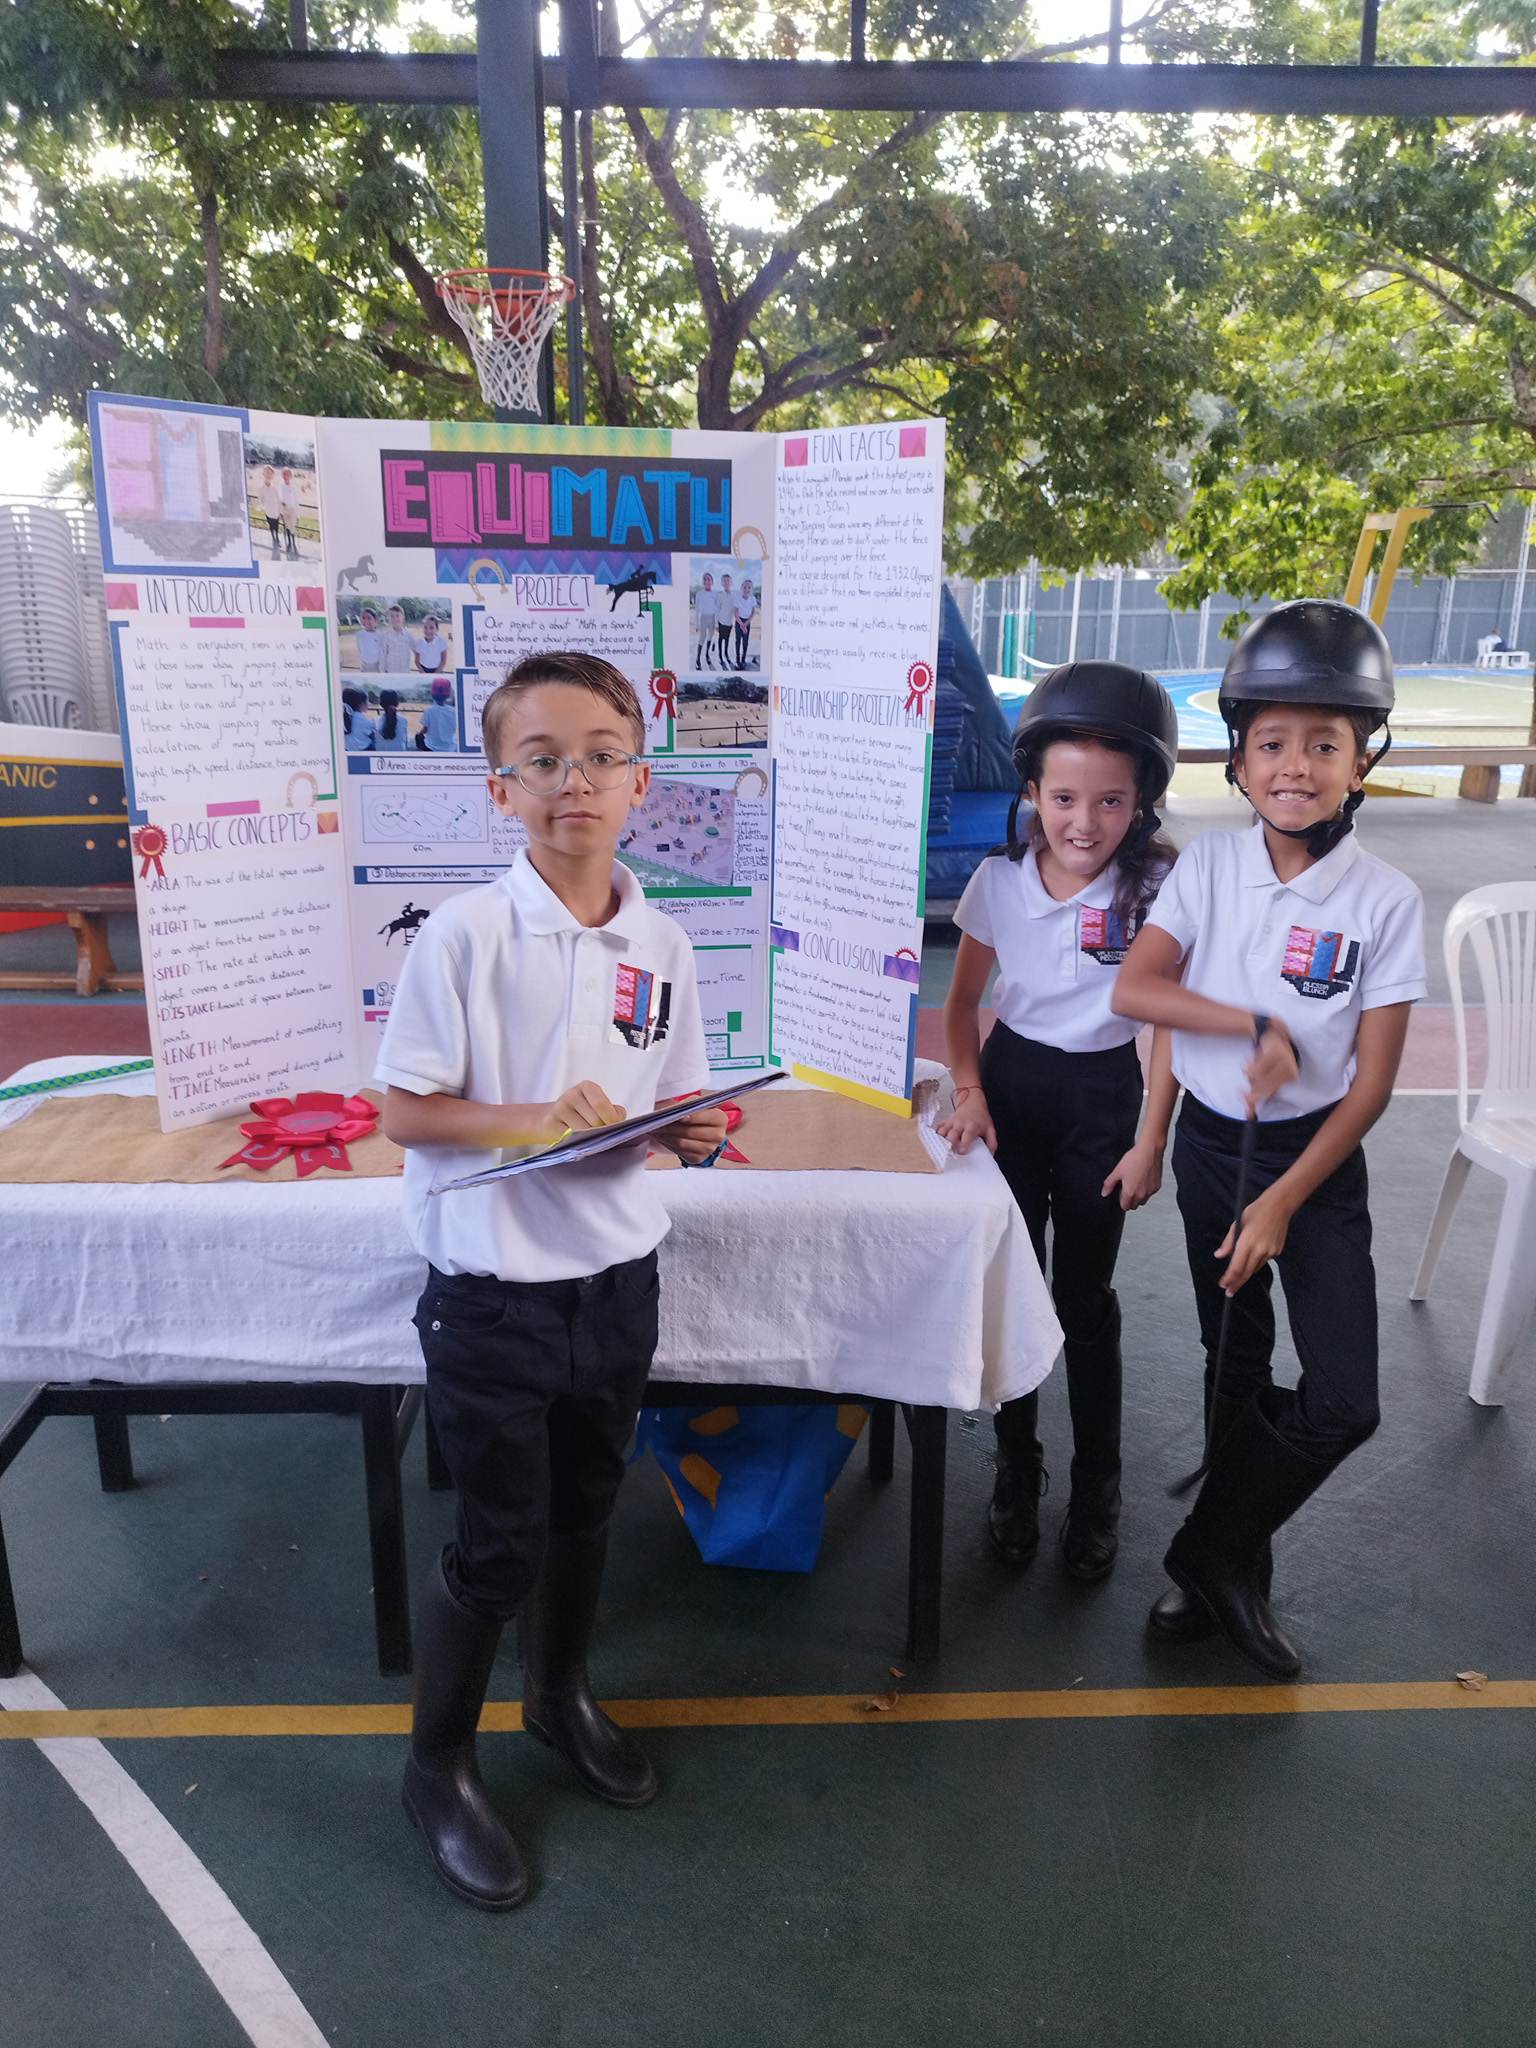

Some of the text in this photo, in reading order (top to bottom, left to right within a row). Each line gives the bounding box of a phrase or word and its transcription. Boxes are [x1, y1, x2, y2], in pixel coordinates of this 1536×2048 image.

[813, 429, 896, 464] FUN FACTS
[384, 459, 729, 546] EQUIMATH
[146, 578, 292, 616] INTRODUCTION
[515, 576, 590, 606] PROJECT
[136, 637, 169, 650] Math
[781, 686, 848, 721] RELATIONSHIP
[647, 759, 679, 769] etween
[172, 812, 311, 855] BASIC CONCEPTS
[804, 931, 882, 976] CONCLUSION
